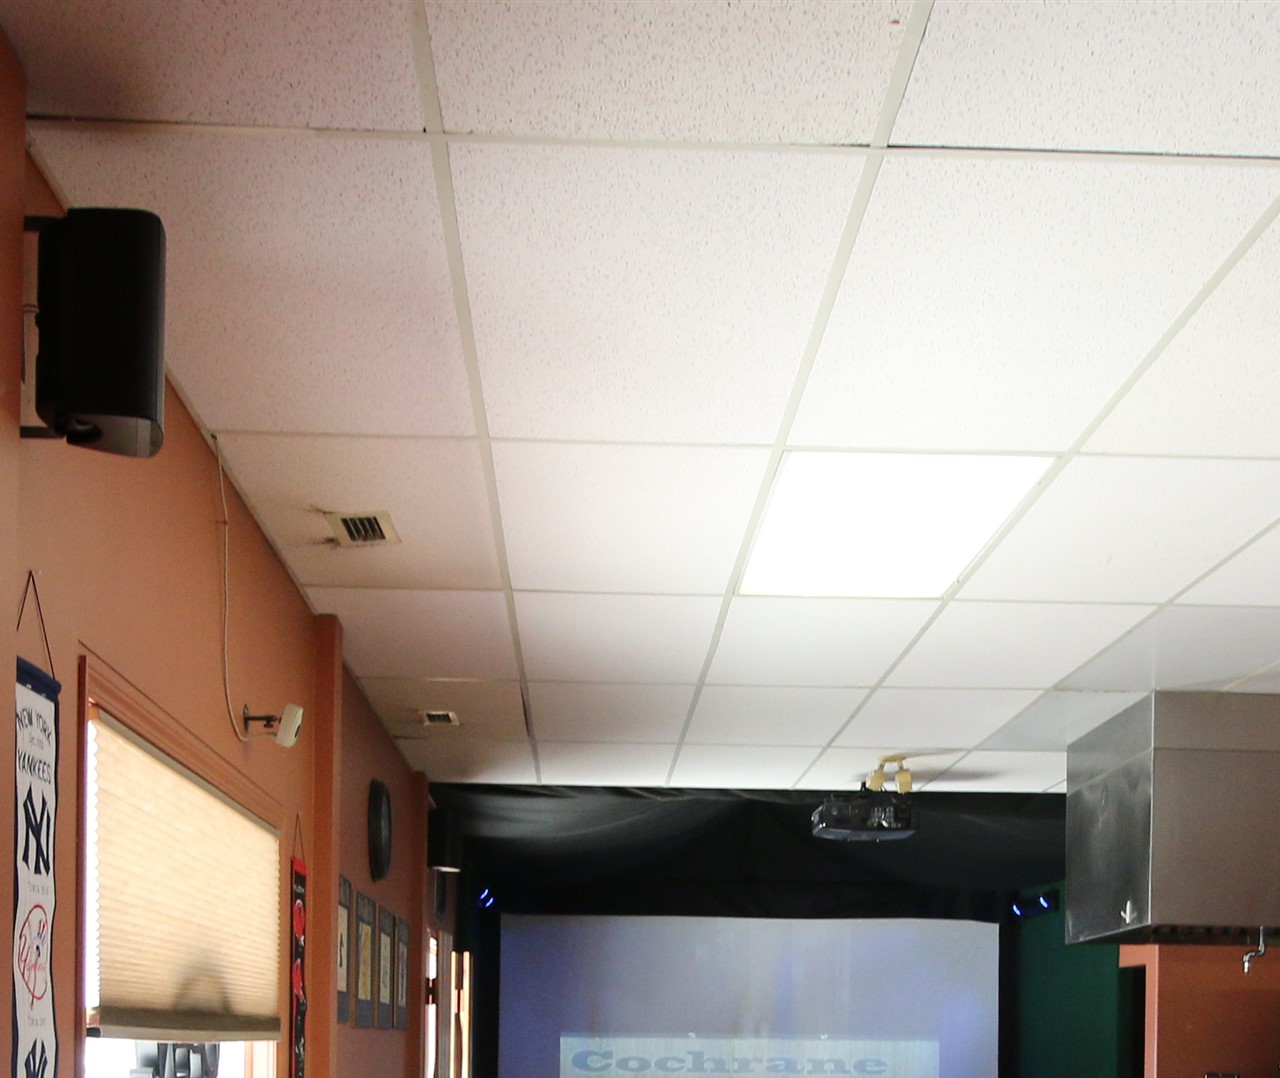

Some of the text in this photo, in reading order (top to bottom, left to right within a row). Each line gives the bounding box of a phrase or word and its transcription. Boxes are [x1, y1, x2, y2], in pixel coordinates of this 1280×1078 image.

[16, 707, 33, 731] NEW
[34, 709, 52, 746] YORK
[17, 749, 52, 784] YANKEES
[571, 1049, 888, 1075] Cochrane
